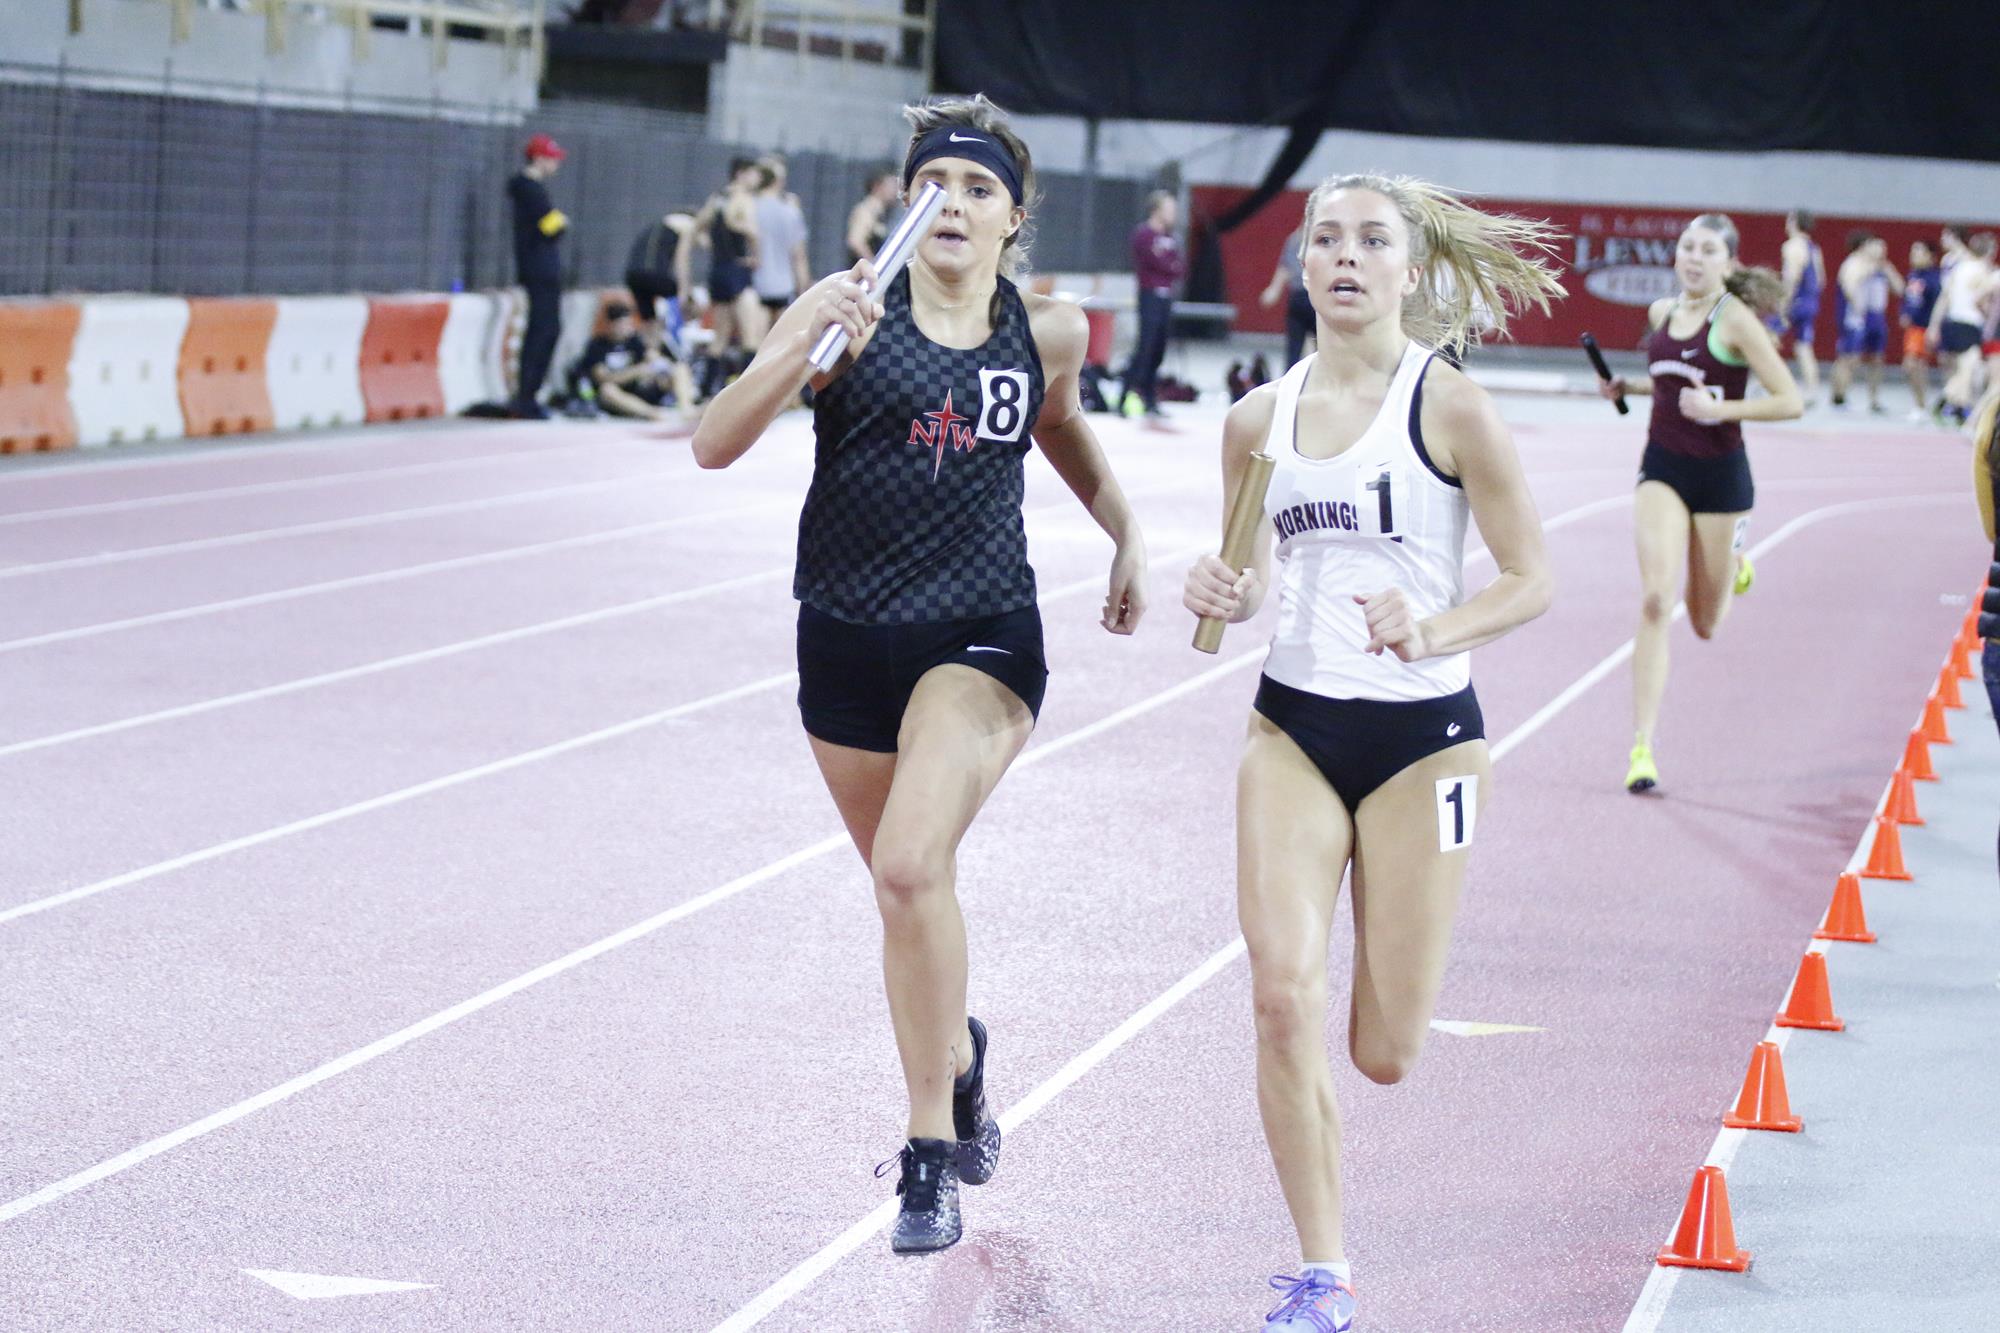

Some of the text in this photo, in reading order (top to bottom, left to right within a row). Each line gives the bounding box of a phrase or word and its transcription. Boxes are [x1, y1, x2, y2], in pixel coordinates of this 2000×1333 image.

[986, 375, 1021, 436] 8
[1365, 471, 1394, 534] 1
[1445, 781, 1463, 844] 1
